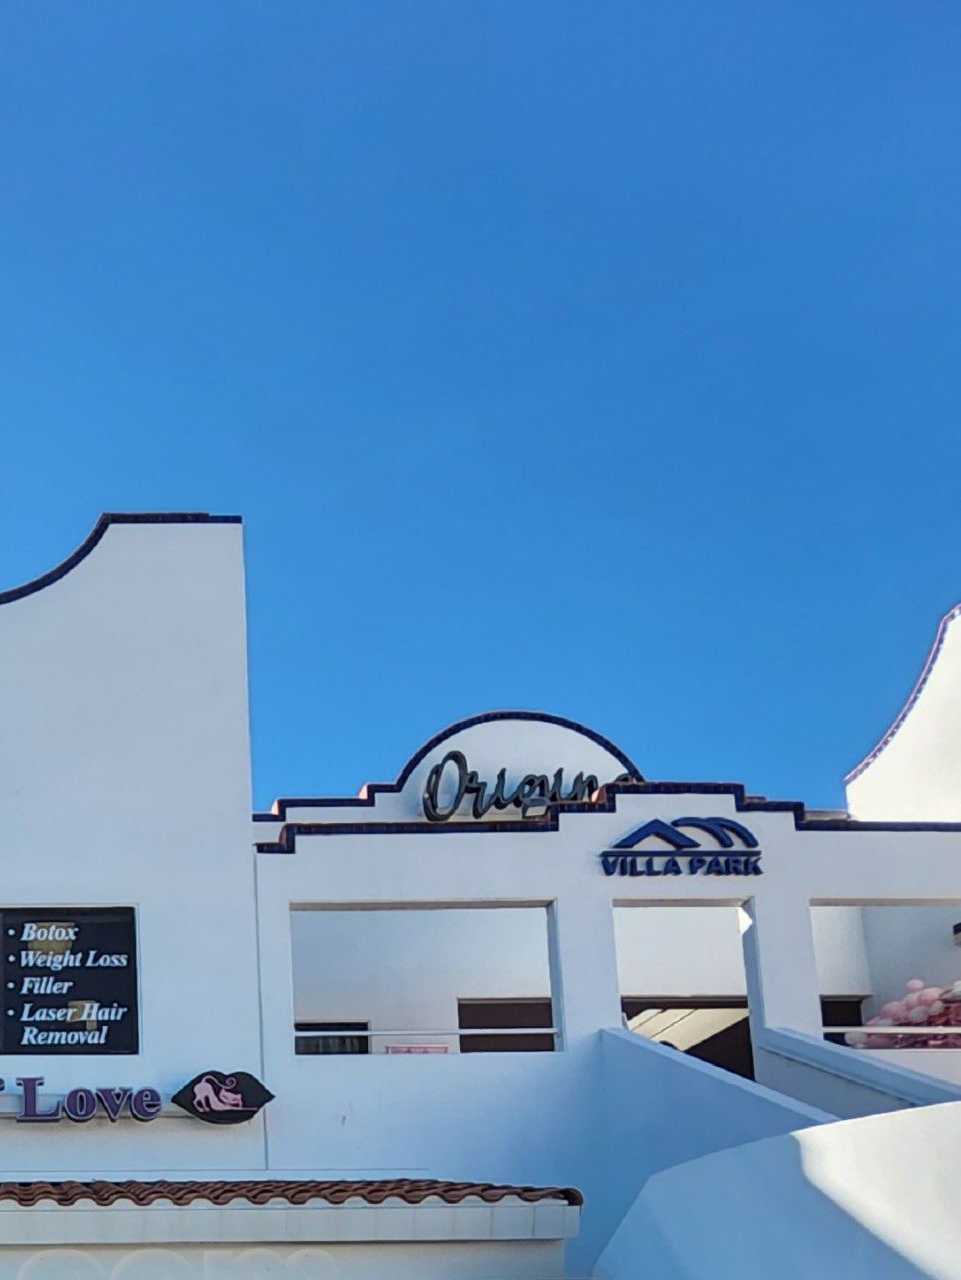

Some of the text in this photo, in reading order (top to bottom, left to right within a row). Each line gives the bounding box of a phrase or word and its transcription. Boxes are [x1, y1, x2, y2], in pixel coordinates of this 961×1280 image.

[601, 856, 763, 876] VILLA PARK
[20, 922, 79, 941] Botox
[20, 949, 128, 971] Weight Loss
[20, 976, 74, 994] Filler
[20, 1003, 128, 1021] Laser Hair
[20, 1026, 109, 1045] Removal
[15, 1076, 163, 1122] Love
